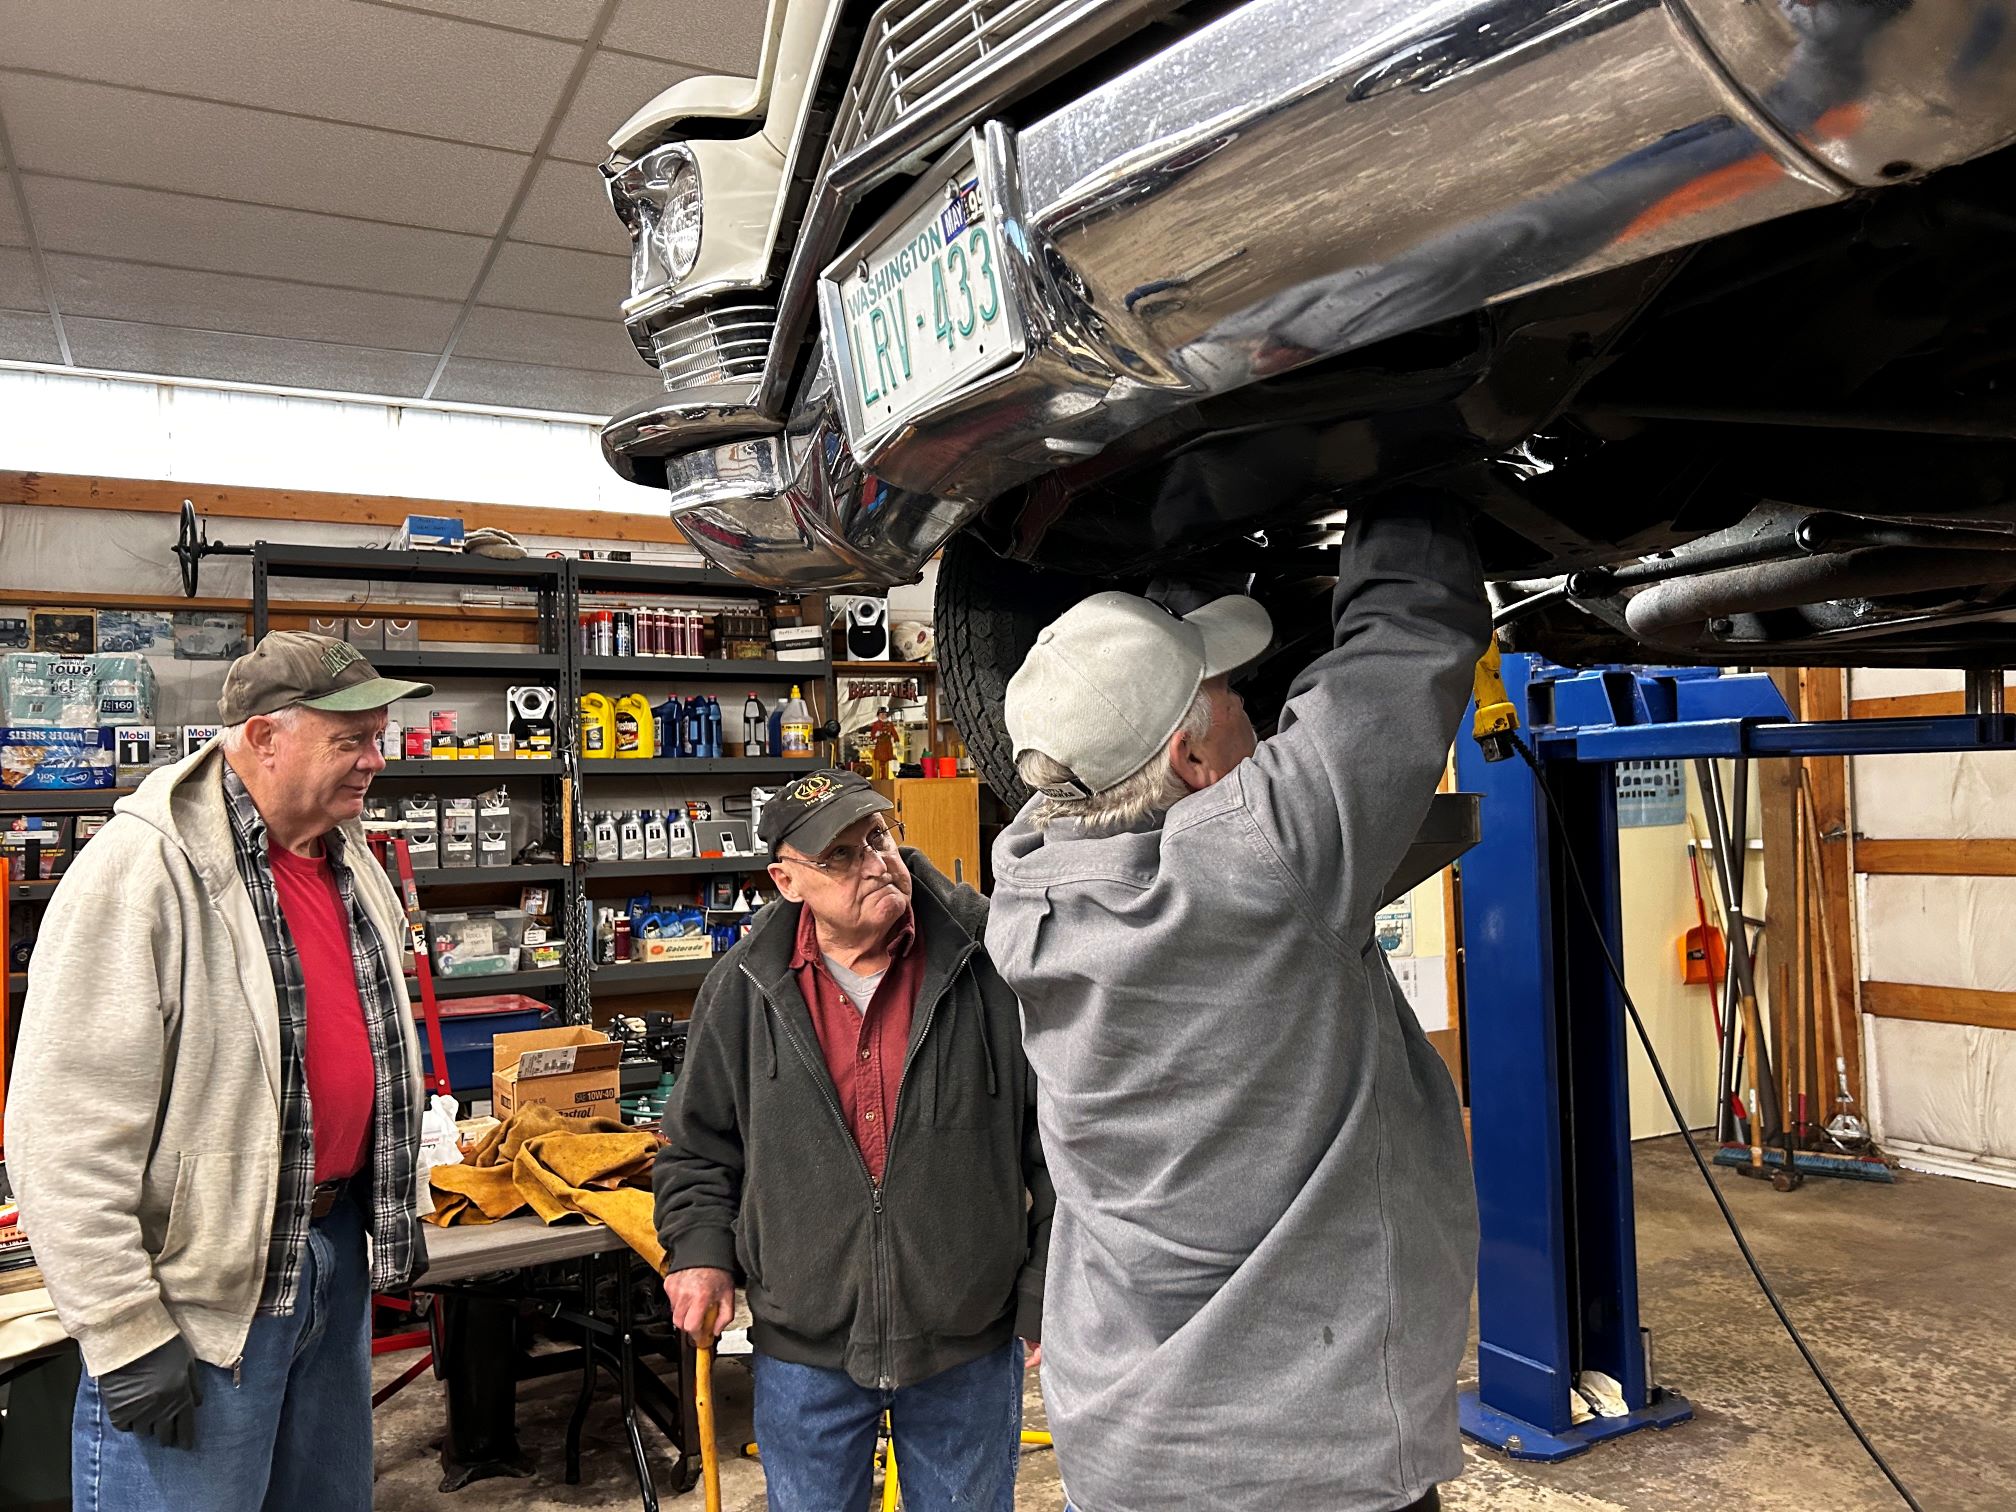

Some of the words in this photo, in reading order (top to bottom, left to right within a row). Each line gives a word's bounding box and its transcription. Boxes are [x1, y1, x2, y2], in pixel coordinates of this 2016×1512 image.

[944, 200, 966, 238] MAY
[847, 221, 942, 317] WASHINGTON
[47, 662, 97, 676] Towel
[848, 679, 918, 702] BEEFEATER
[114, 701, 133, 709] 160
[119, 731, 149, 740] Mobil
[188, 728, 218, 737] Mobil
[127, 742, 139, 763] 1
[587, 1089, 614, 1101] 10W-40
